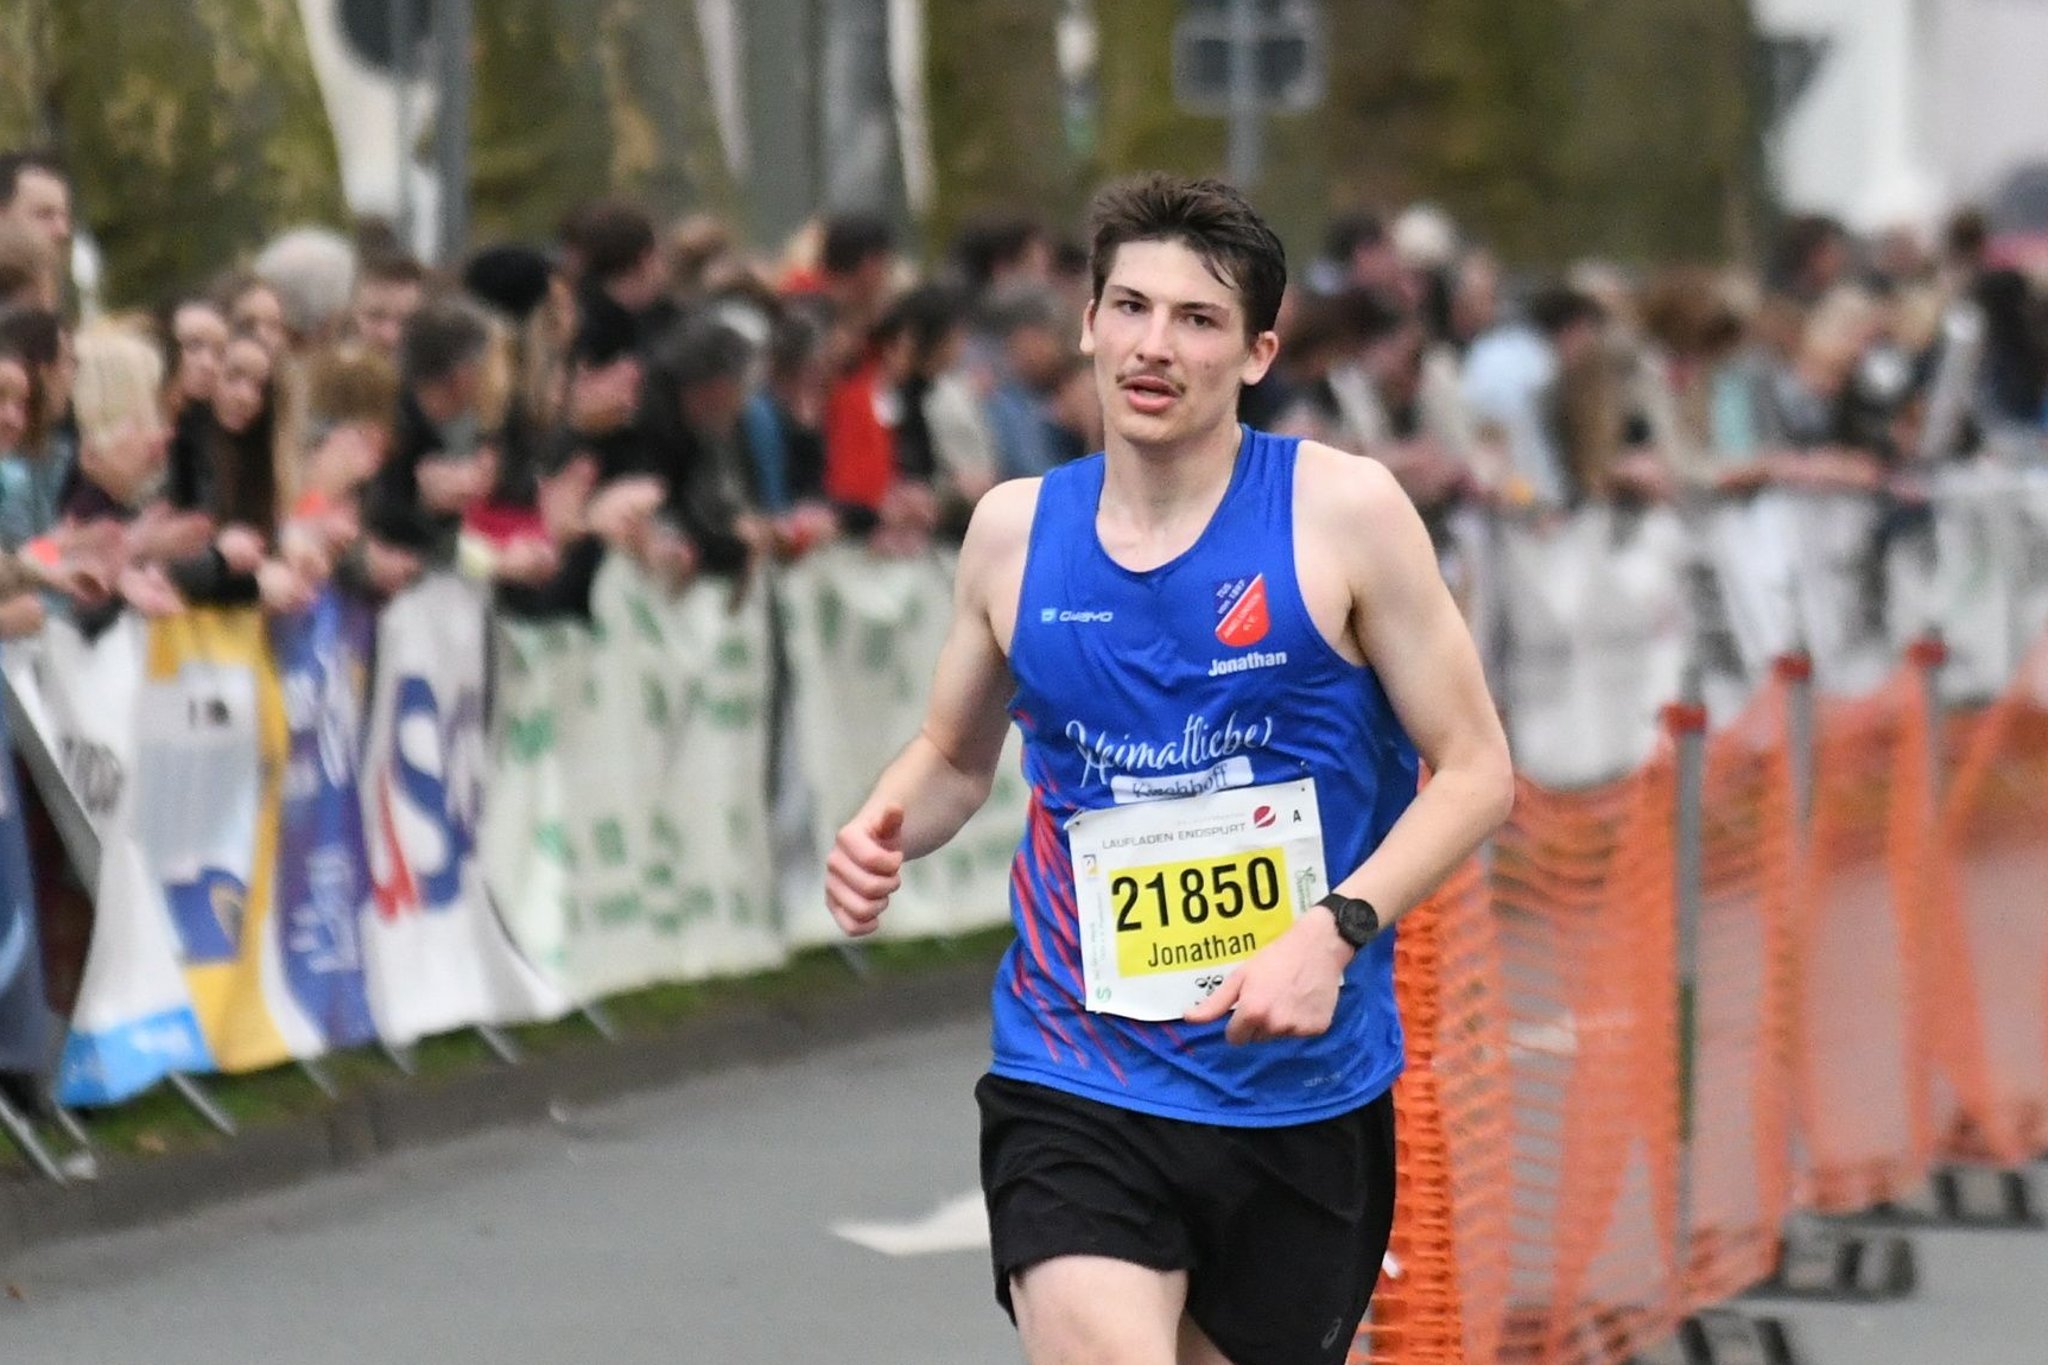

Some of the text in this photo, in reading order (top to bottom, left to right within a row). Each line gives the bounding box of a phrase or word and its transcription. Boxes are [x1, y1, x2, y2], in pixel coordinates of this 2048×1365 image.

[1208, 652, 1287, 677] Jonathan
[1292, 809, 1302, 823] A
[1102, 822, 1246, 849] LAUFLADEN ENDSPURT
[1111, 856, 1279, 932] 21850
[1147, 932, 1257, 967] Jonathan
